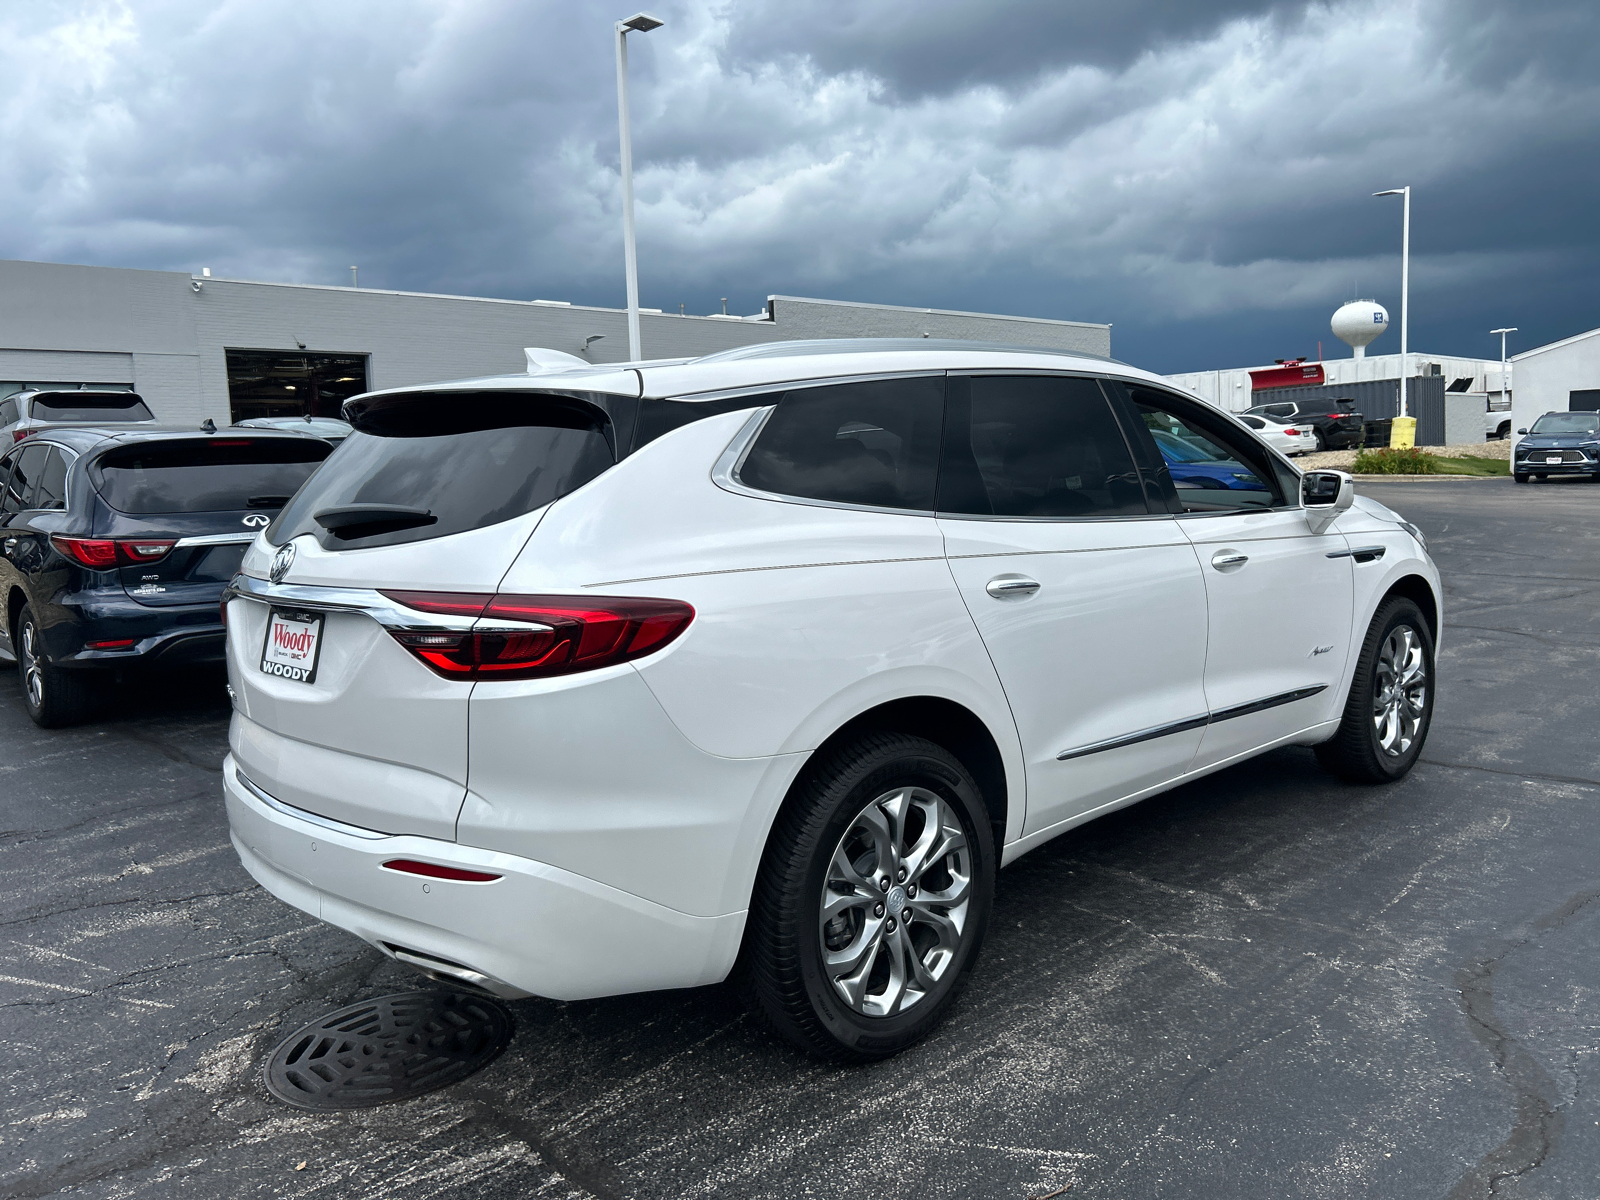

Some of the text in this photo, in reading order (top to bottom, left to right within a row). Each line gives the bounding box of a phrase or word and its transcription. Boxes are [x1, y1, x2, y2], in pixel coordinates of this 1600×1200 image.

[296, 612, 311, 621] GMC
[274, 622, 316, 659] Woody
[290, 652, 302, 661] GMC
[262, 660, 310, 682] WOODY
